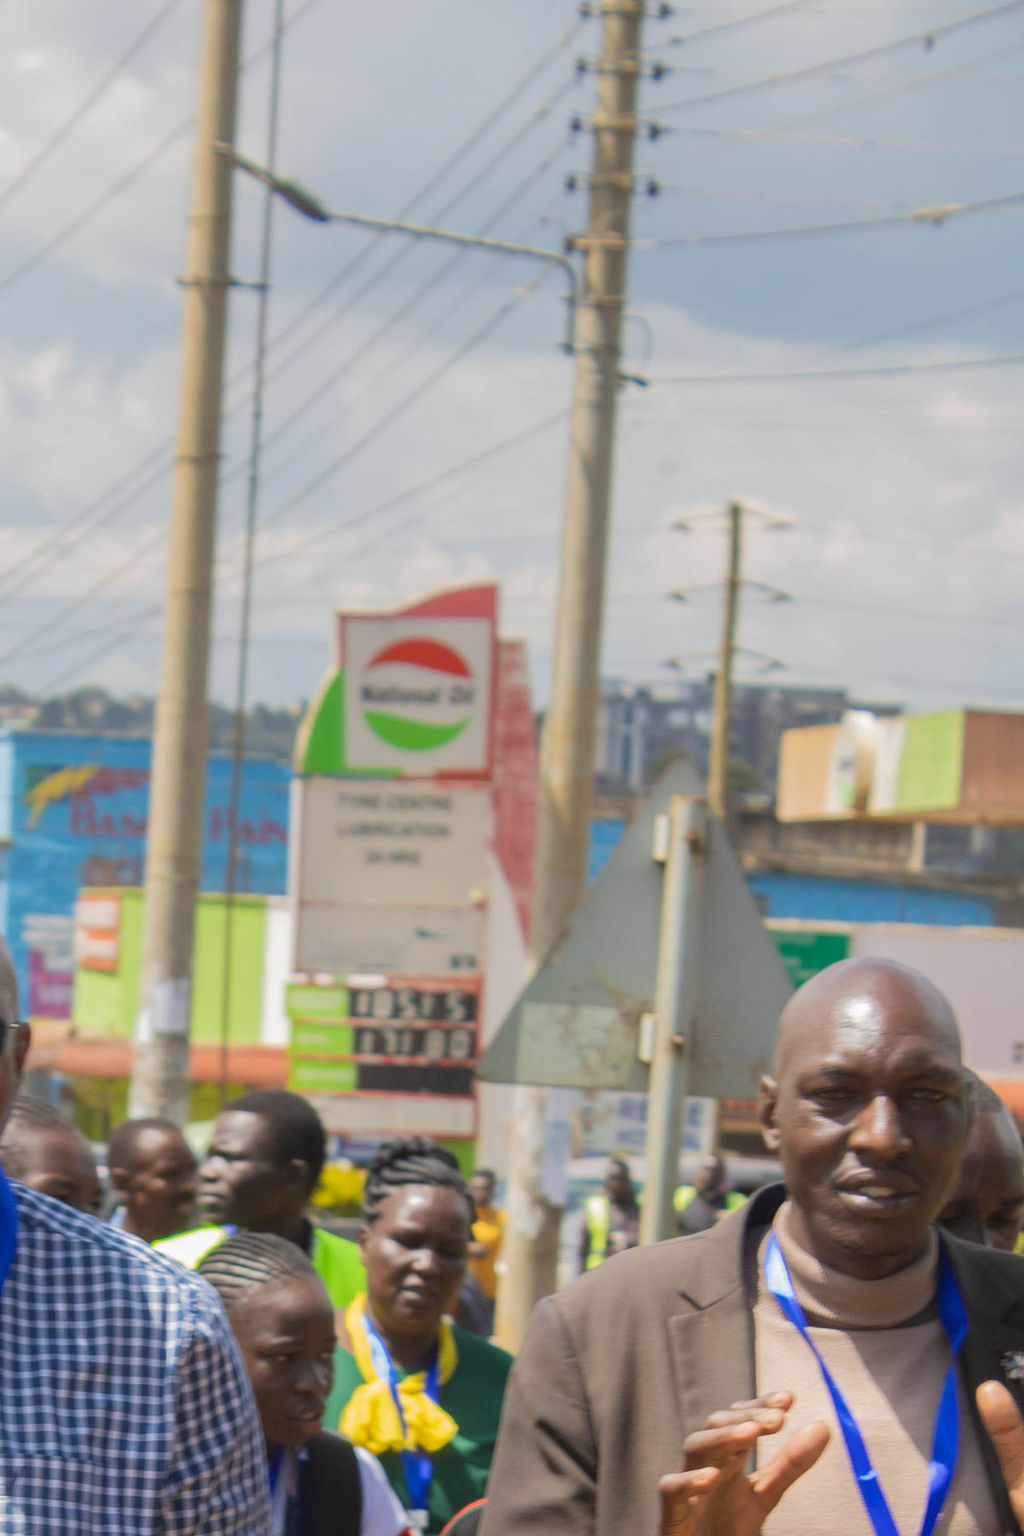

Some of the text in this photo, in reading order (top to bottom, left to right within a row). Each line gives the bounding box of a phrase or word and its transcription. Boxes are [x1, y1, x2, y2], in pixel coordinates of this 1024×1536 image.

[360, 683, 475, 704] National Oil
[386, 794, 453, 812] CENTRE
[336, 822, 450, 838] LUBRICATION
